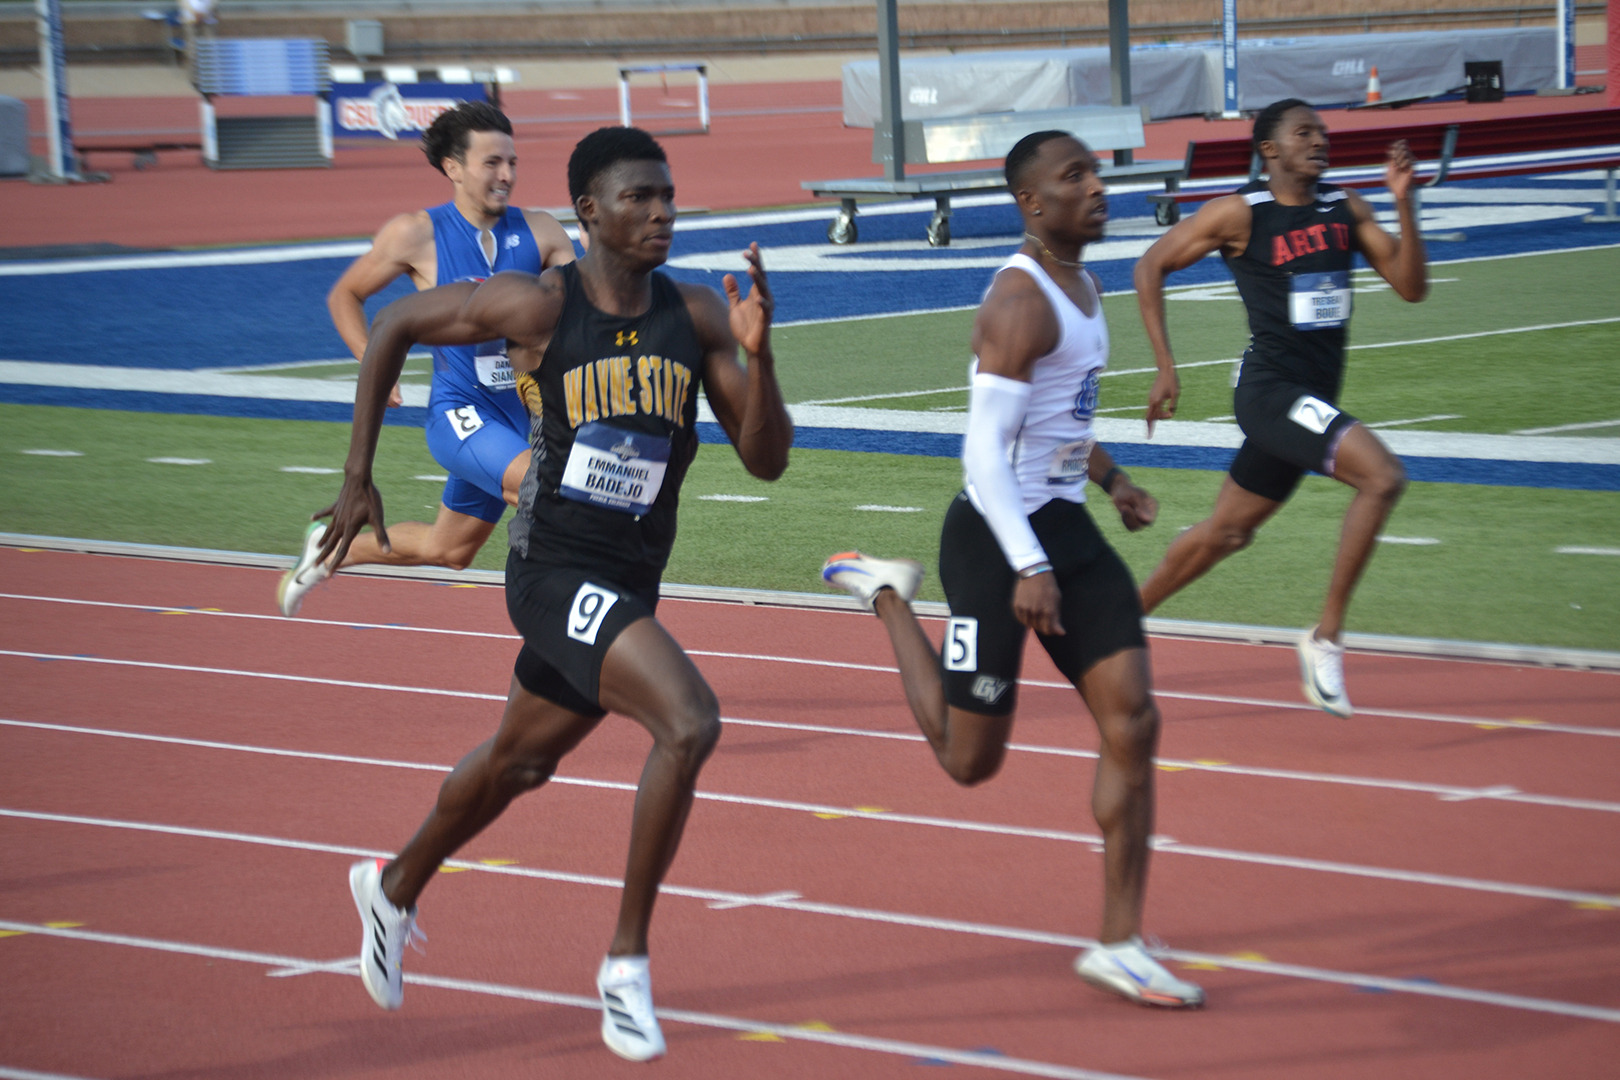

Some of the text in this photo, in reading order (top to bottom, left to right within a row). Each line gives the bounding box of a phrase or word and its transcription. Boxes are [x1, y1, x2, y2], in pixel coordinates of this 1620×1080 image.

[1271, 223, 1329, 267] ART
[491, 370, 516, 383] SIAN
[563, 355, 692, 429] WAYNE STATE
[1300, 403, 1335, 428] 2
[585, 473, 644, 499] BADEJO
[587, 457, 650, 481] EMMANUEL
[574, 592, 605, 634] 9
[952, 623, 970, 665] 5
